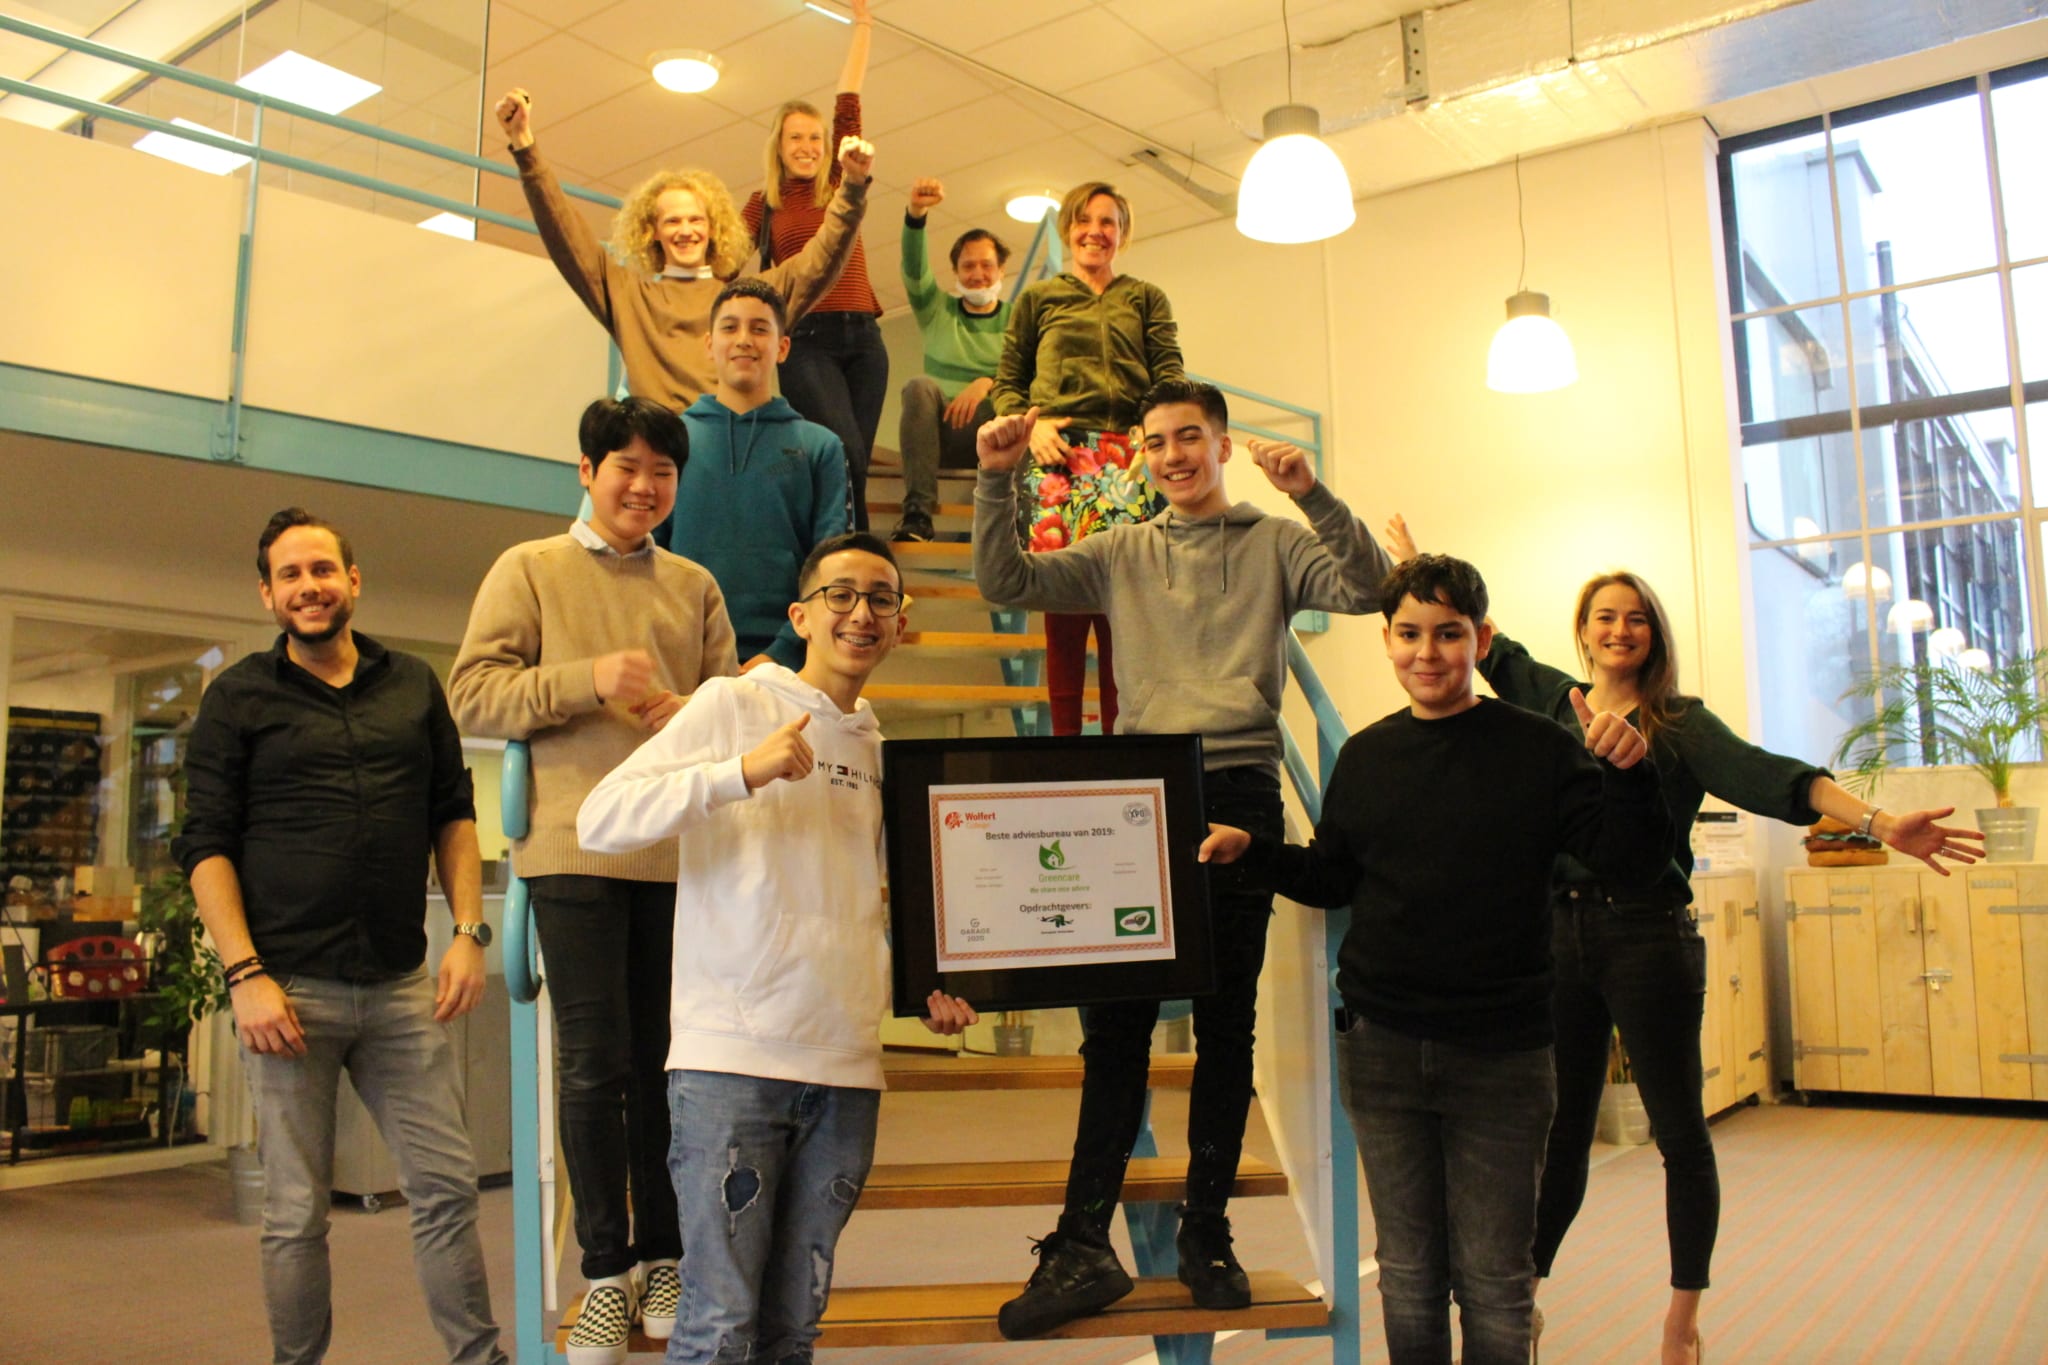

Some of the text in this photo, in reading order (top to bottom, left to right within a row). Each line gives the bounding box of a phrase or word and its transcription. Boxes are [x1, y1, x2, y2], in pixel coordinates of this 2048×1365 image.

[817, 760, 833, 773] MY
[964, 811, 996, 821] Wolfert
[985, 827, 1116, 841] Beste adviesbureau van 2019:
[1038, 874, 1081, 883] Greencare
[1019, 902, 1092, 914] Opdrachtgevers:
[960, 928, 990, 936] GARAGE
